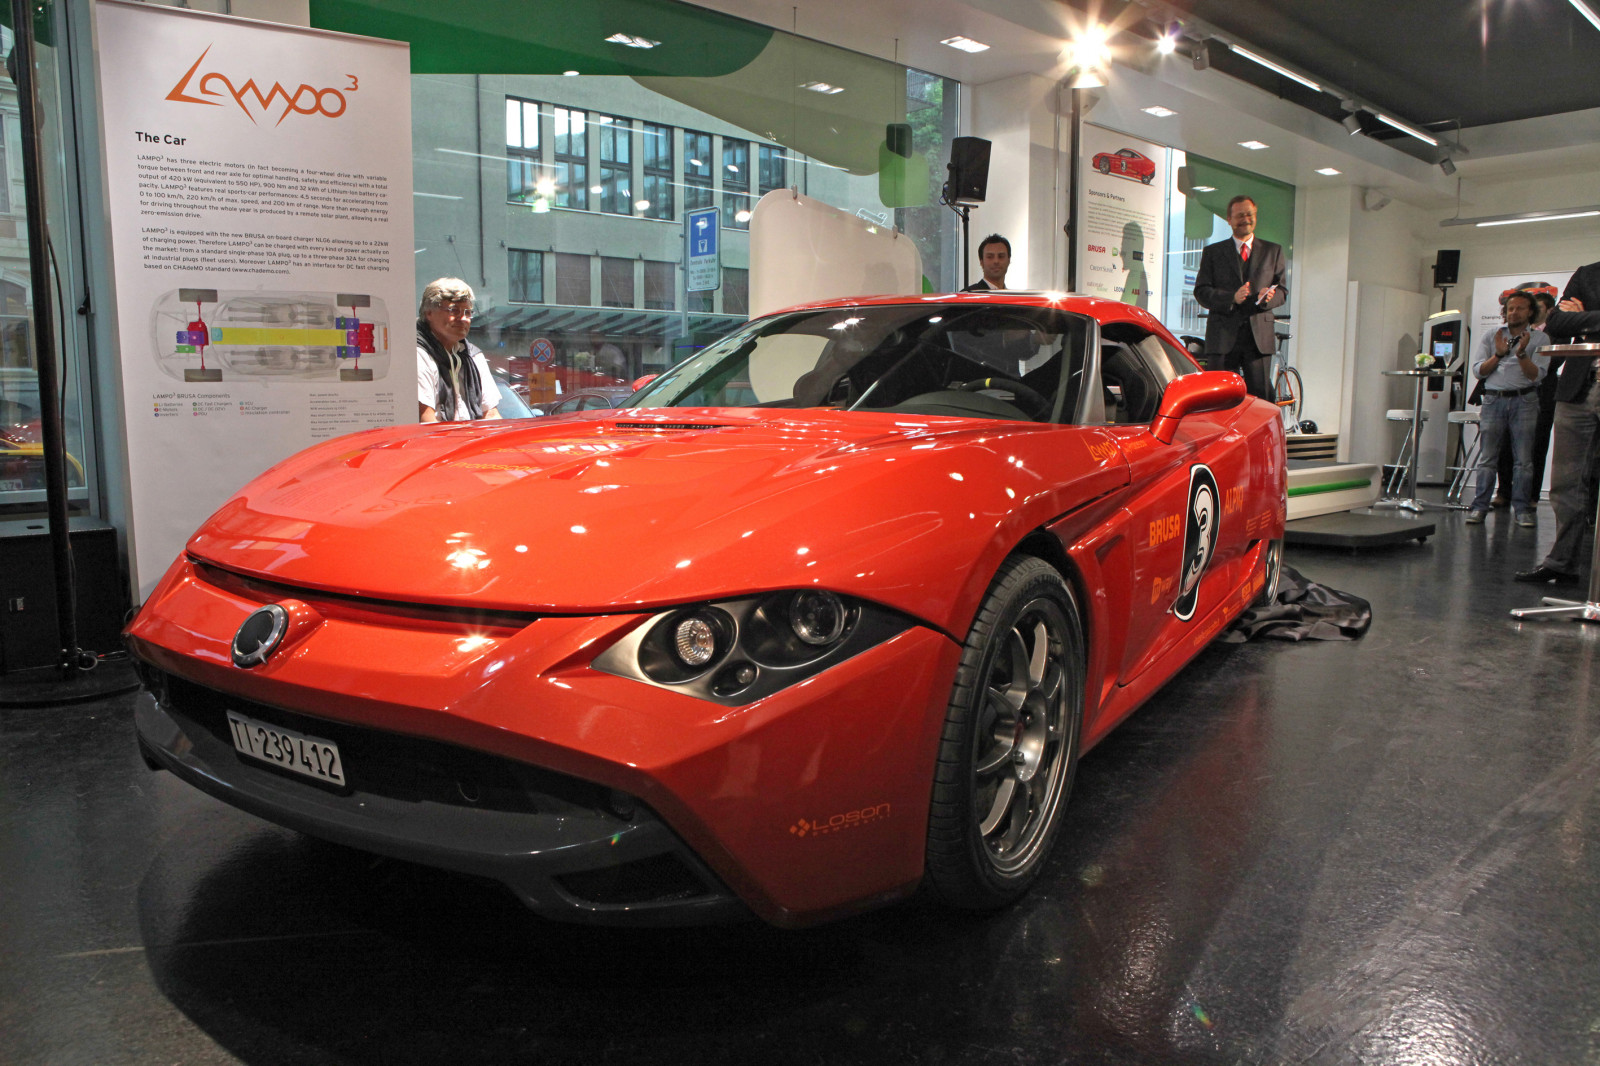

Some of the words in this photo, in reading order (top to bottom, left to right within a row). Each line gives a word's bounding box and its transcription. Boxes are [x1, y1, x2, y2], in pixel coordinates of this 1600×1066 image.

[135, 131, 160, 143] The
[164, 134, 187, 146] Car
[271, 166, 299, 174] becoming
[306, 169, 335, 177] four-wheel
[188, 185, 214, 193] features
[342, 198, 375, 206] accelerating
[150, 201, 173, 209] driving
[1088, 244, 1106, 254] BRUSA
[1149, 513, 1181, 547] BRUSA
